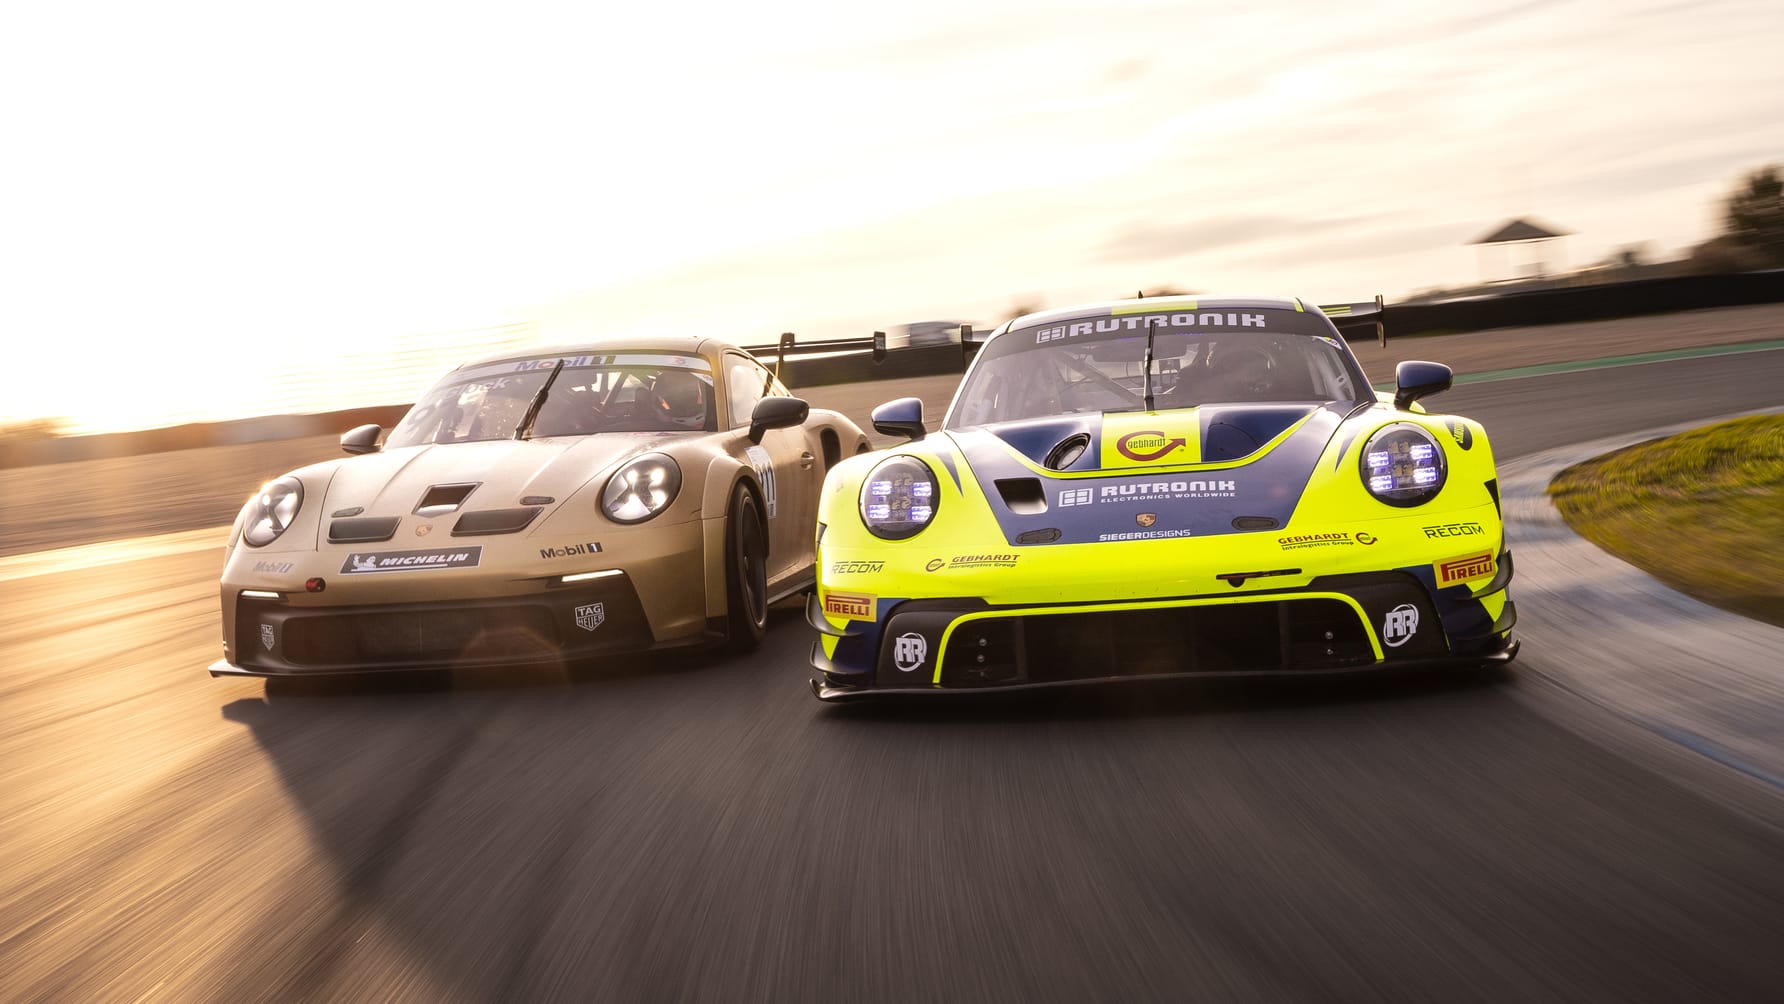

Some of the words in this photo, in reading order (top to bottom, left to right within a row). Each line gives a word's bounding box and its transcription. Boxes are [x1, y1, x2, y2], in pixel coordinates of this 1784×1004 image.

[1069, 313, 1266, 337] RUTRONIK
[1127, 438, 1166, 449] gebhardt
[1101, 481, 1236, 497] RUTRONIK
[1101, 494, 1170, 503] ELECTRONICS
[1099, 529, 1191, 542] SIEGERDESIGNS
[1422, 522, 1485, 539] RECOM
[1278, 532, 1348, 544] GEBHARDT
[540, 544, 586, 559] Mobil
[952, 554, 1020, 563] GEBHARDT
[380, 553, 468, 566] MICHELIN
[832, 562, 885, 574] RECOM
[1440, 554, 1492, 582] PIRELLI
[578, 605, 601, 617] TAG
[825, 594, 870, 617] PIRELLI
[577, 615, 604, 629] HEUER
[1386, 609, 1417, 638] RR
[896, 637, 925, 663] RR
